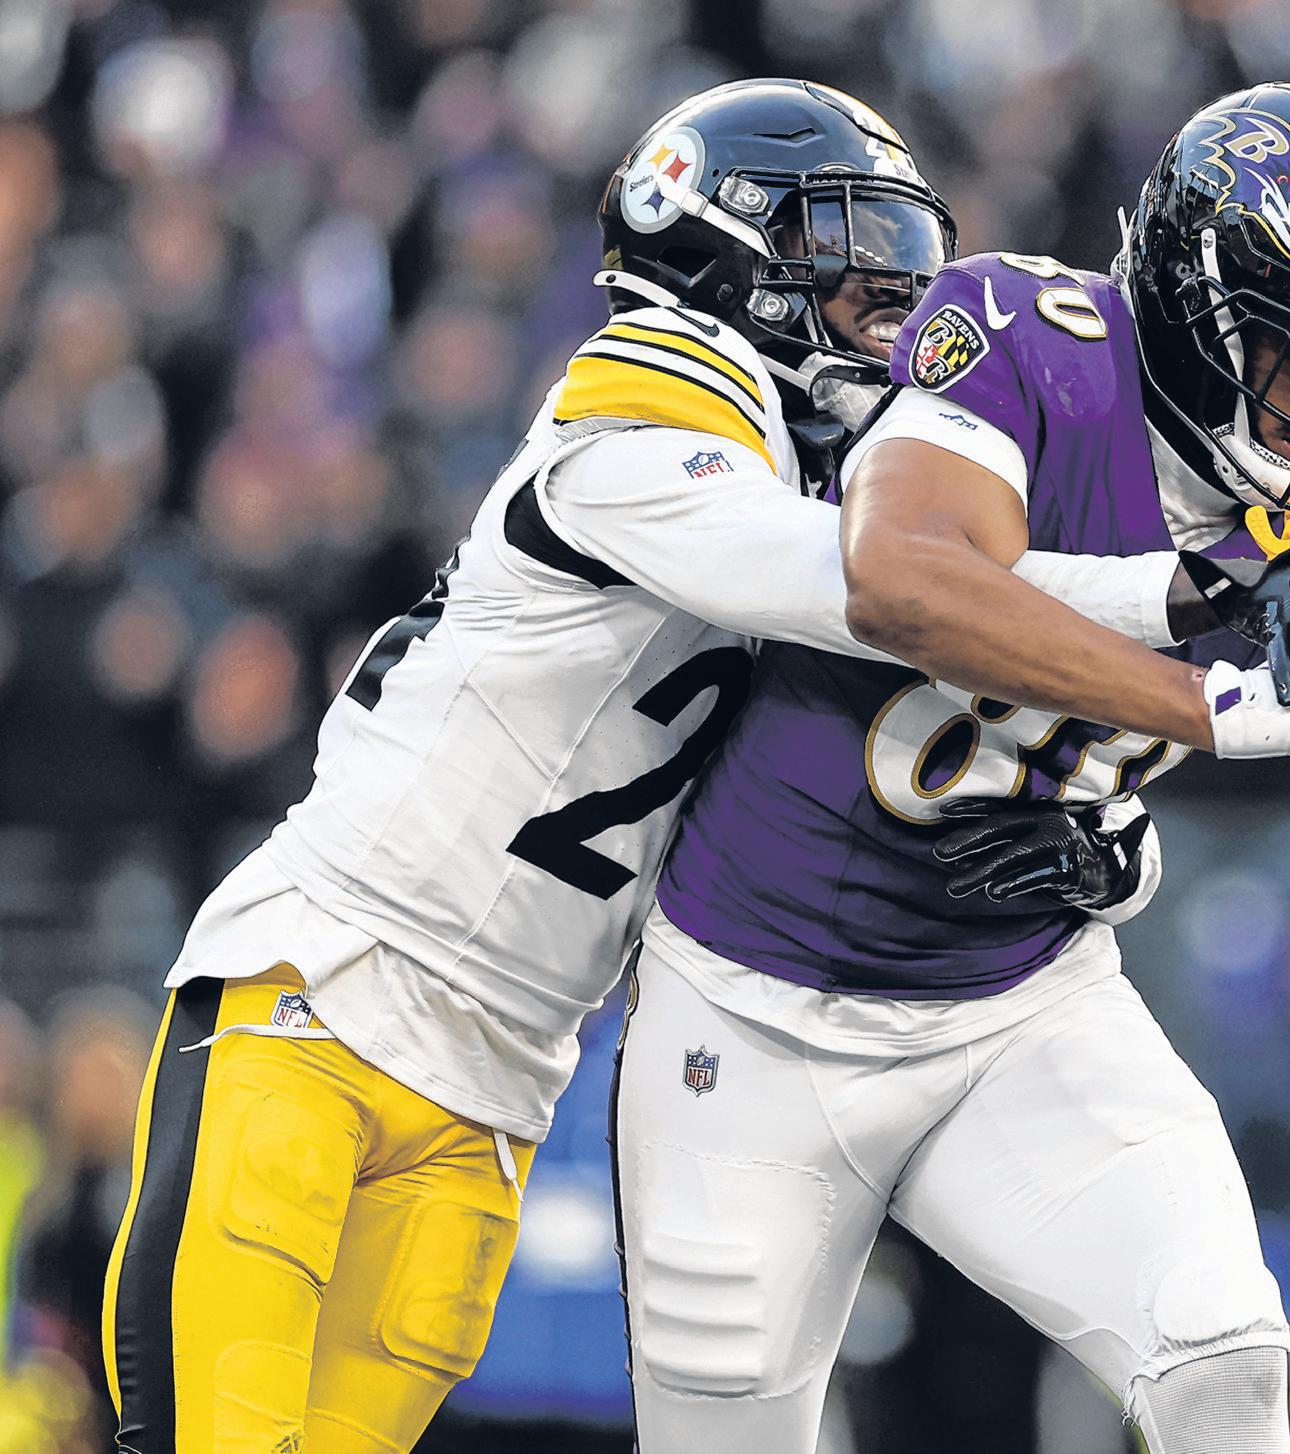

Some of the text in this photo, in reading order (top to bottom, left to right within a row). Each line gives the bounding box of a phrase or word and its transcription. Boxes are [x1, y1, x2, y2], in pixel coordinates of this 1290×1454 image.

[941, 310, 980, 350] RAVENS
[277, 1007, 303, 1028] NFL
[687, 1067, 711, 1087] NFL
